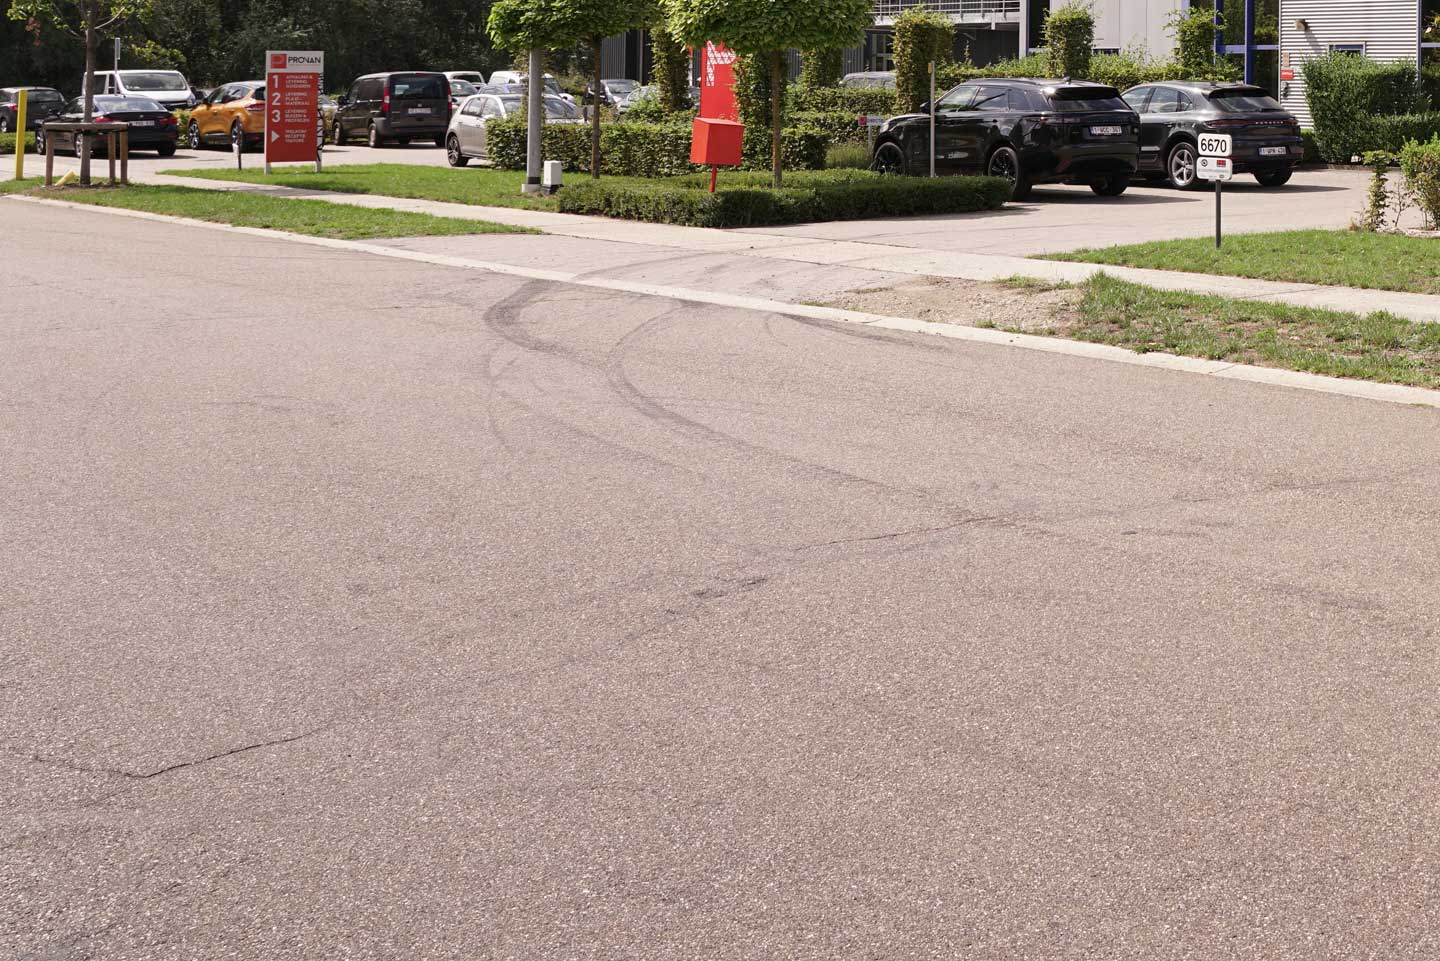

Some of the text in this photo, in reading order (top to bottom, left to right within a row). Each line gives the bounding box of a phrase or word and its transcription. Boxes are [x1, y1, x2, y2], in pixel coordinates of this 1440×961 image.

[288, 56, 321, 64] PROVAN
[272, 74, 279, 88] 1
[272, 92, 281, 105] 2
[272, 109, 281, 123] 3
[1200, 138, 1227, 153] 6670
